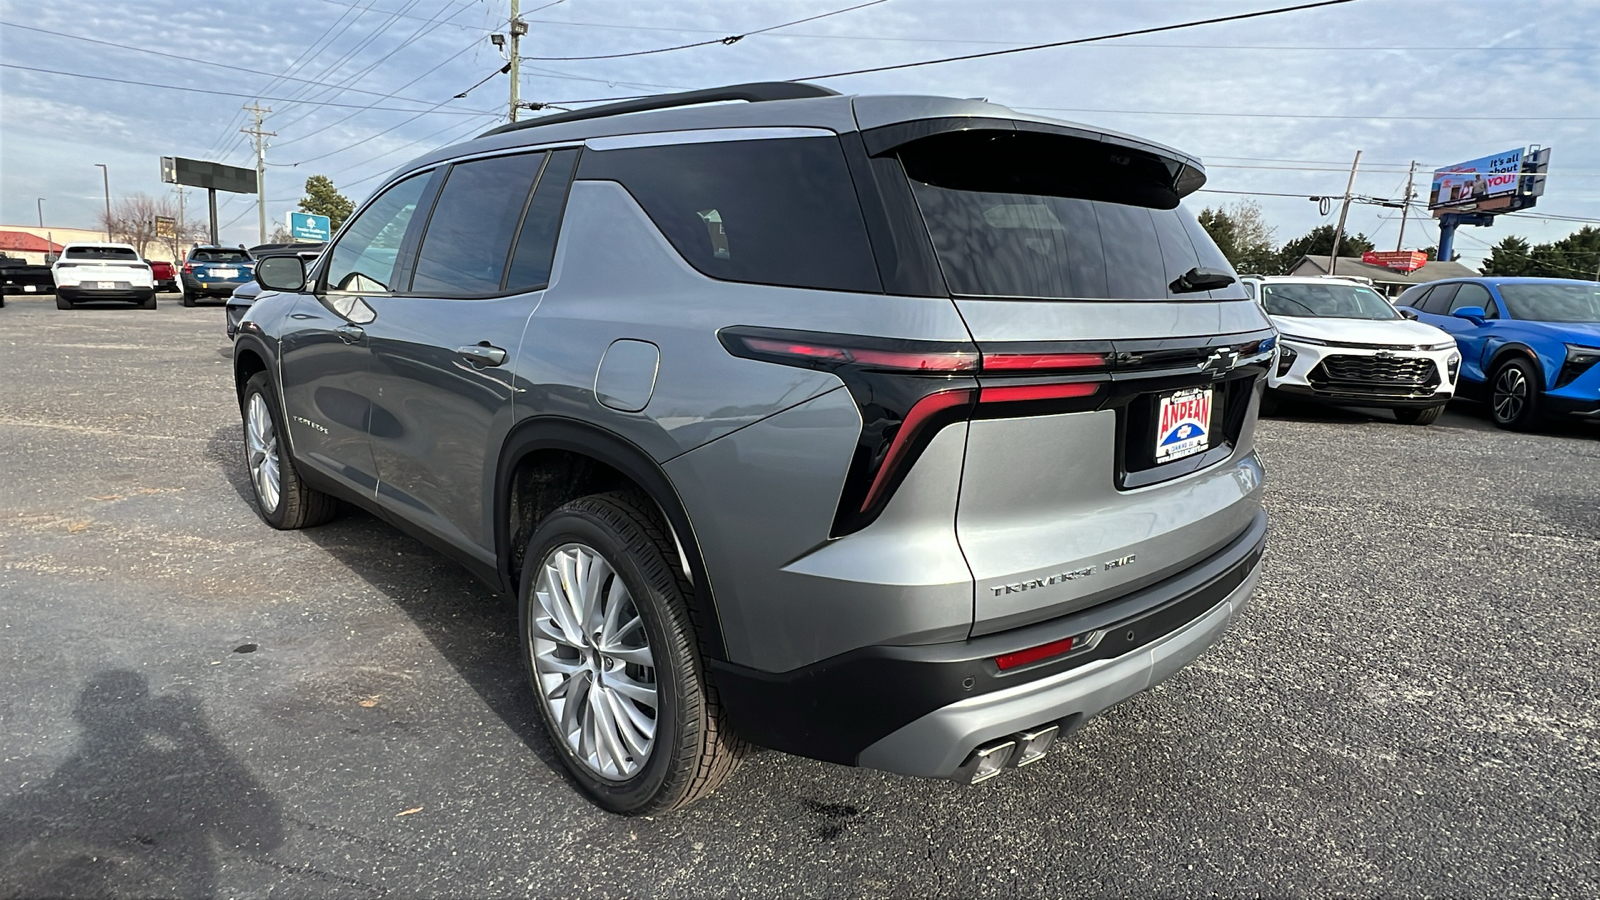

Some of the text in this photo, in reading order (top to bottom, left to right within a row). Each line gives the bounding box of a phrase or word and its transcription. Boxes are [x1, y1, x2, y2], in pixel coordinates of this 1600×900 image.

[1490, 153, 1519, 168] It's all
[1488, 163, 1518, 177] about
[1487, 174, 1515, 187] YOU!
[292, 415, 329, 435] TRAVERSE
[1160, 396, 1209, 440] ANDEAN
[990, 554, 1136, 597] TRAVERSE AWD
